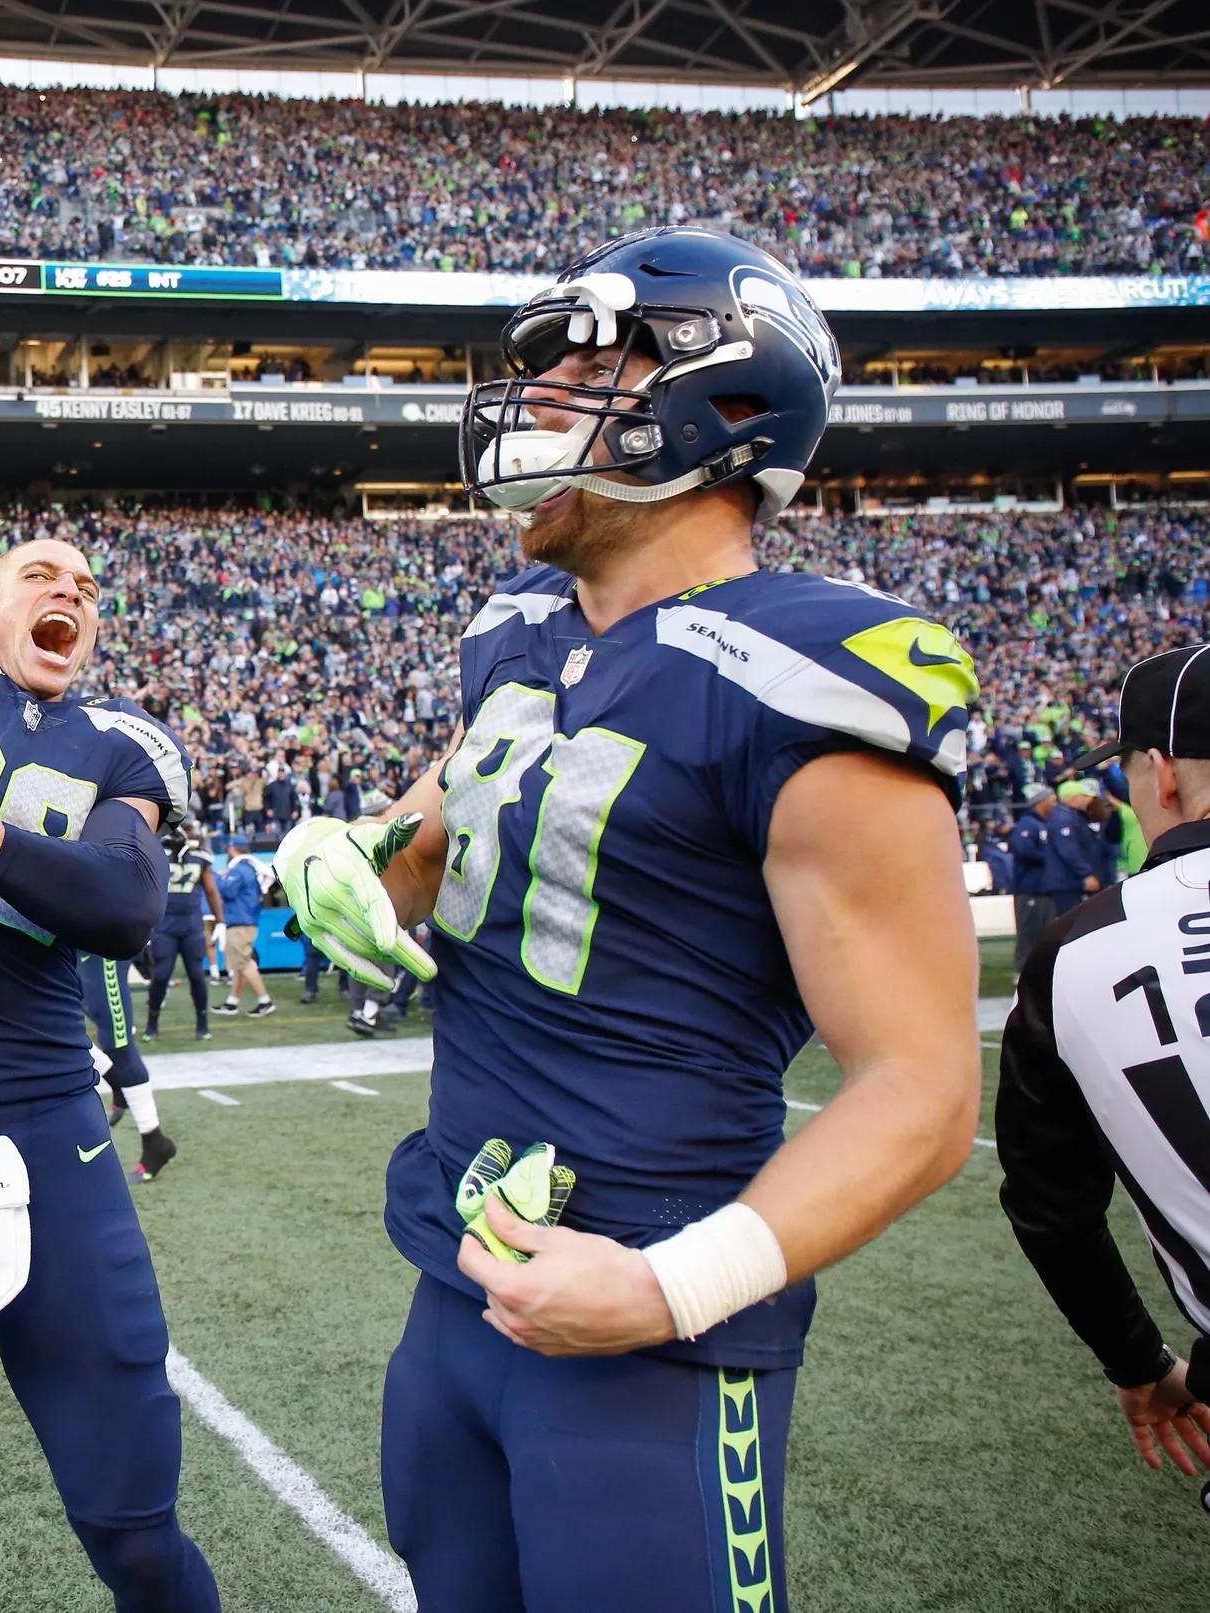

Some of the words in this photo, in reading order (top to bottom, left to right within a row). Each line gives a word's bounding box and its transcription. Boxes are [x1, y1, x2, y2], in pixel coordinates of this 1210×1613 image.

[149, 272, 182, 288] INT
[36, 400, 61, 418] 45
[62, 401, 109, 419] KENNY
[111, 402, 161, 420] EASLEY
[233, 401, 253, 420] 17
[254, 402, 289, 421] DAVE
[290, 402, 332, 422] KRIEG
[425, 403, 464, 423] CHUC
[845, 404, 883, 423] JONES
[946, 402, 987, 421] RING
[989, 402, 1009, 420] OF
[1011, 401, 1065, 420] HONOR
[168, 862, 201, 894] 27
